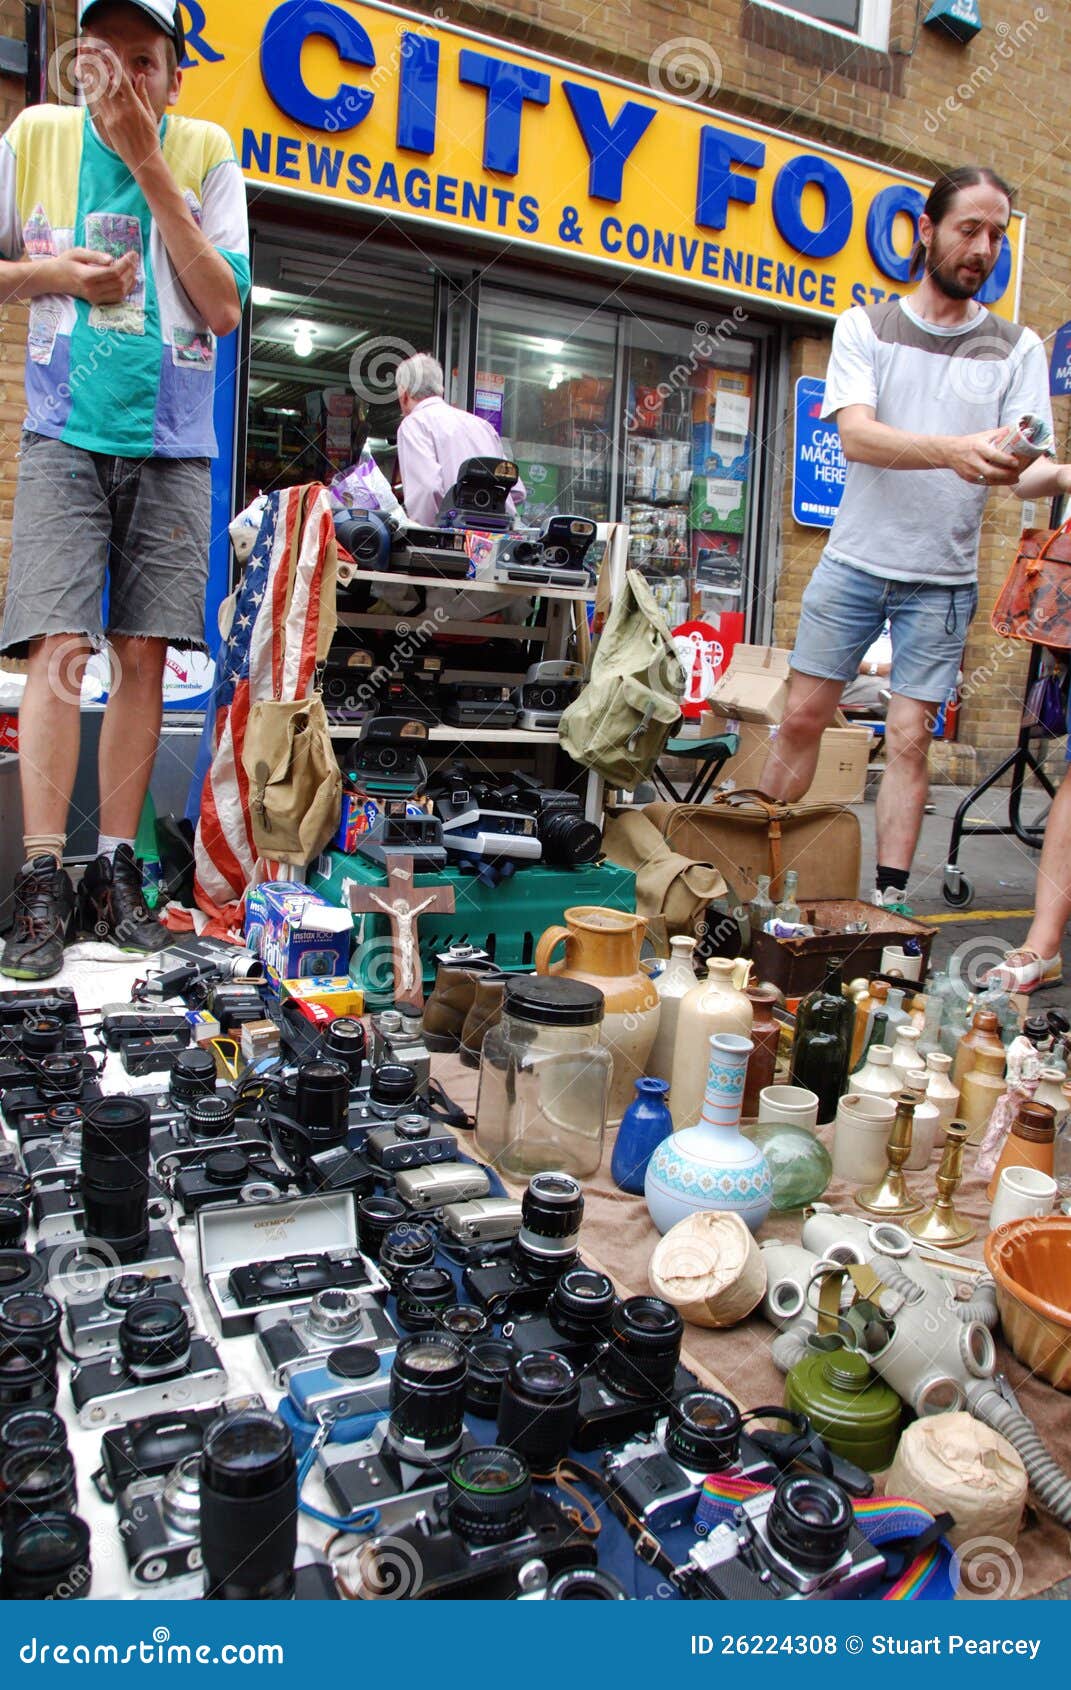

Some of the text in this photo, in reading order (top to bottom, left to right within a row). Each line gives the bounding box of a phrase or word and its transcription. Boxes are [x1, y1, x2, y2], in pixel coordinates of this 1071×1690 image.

[259, 0, 657, 203] CITY
[242, 128, 540, 234] NEWSAGENTS
[559, 206, 584, 245] &
[600, 217, 836, 307] CONVENIENCE
[815, 466, 847, 485] HERE
